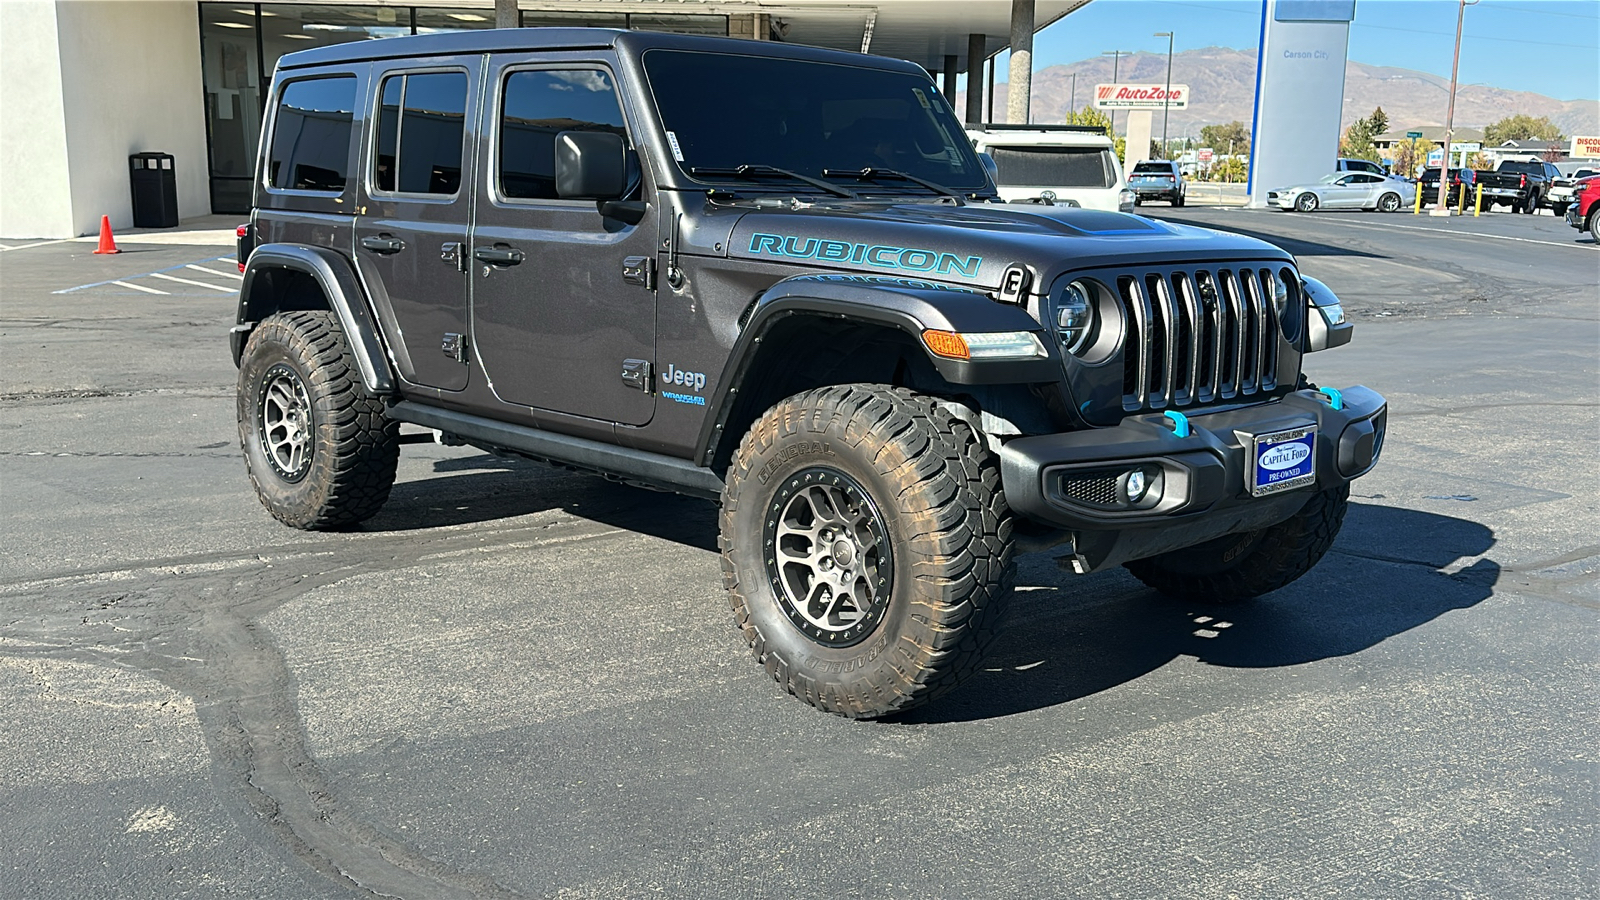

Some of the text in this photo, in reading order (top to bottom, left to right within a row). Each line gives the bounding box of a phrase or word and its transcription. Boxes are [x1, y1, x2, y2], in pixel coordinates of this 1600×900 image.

[1284, 50, 1329, 60] Carson City
[1115, 87, 1182, 100] AutoZone
[749, 233, 982, 278] RUBICON
[662, 364, 706, 392] Jeep
[662, 391, 706, 402] WRANGLER
[757, 441, 835, 485] GENERAL
[1262, 449, 1308, 466] CAPITAL FORD
[1269, 467, 1301, 481] PRE-OWNED
